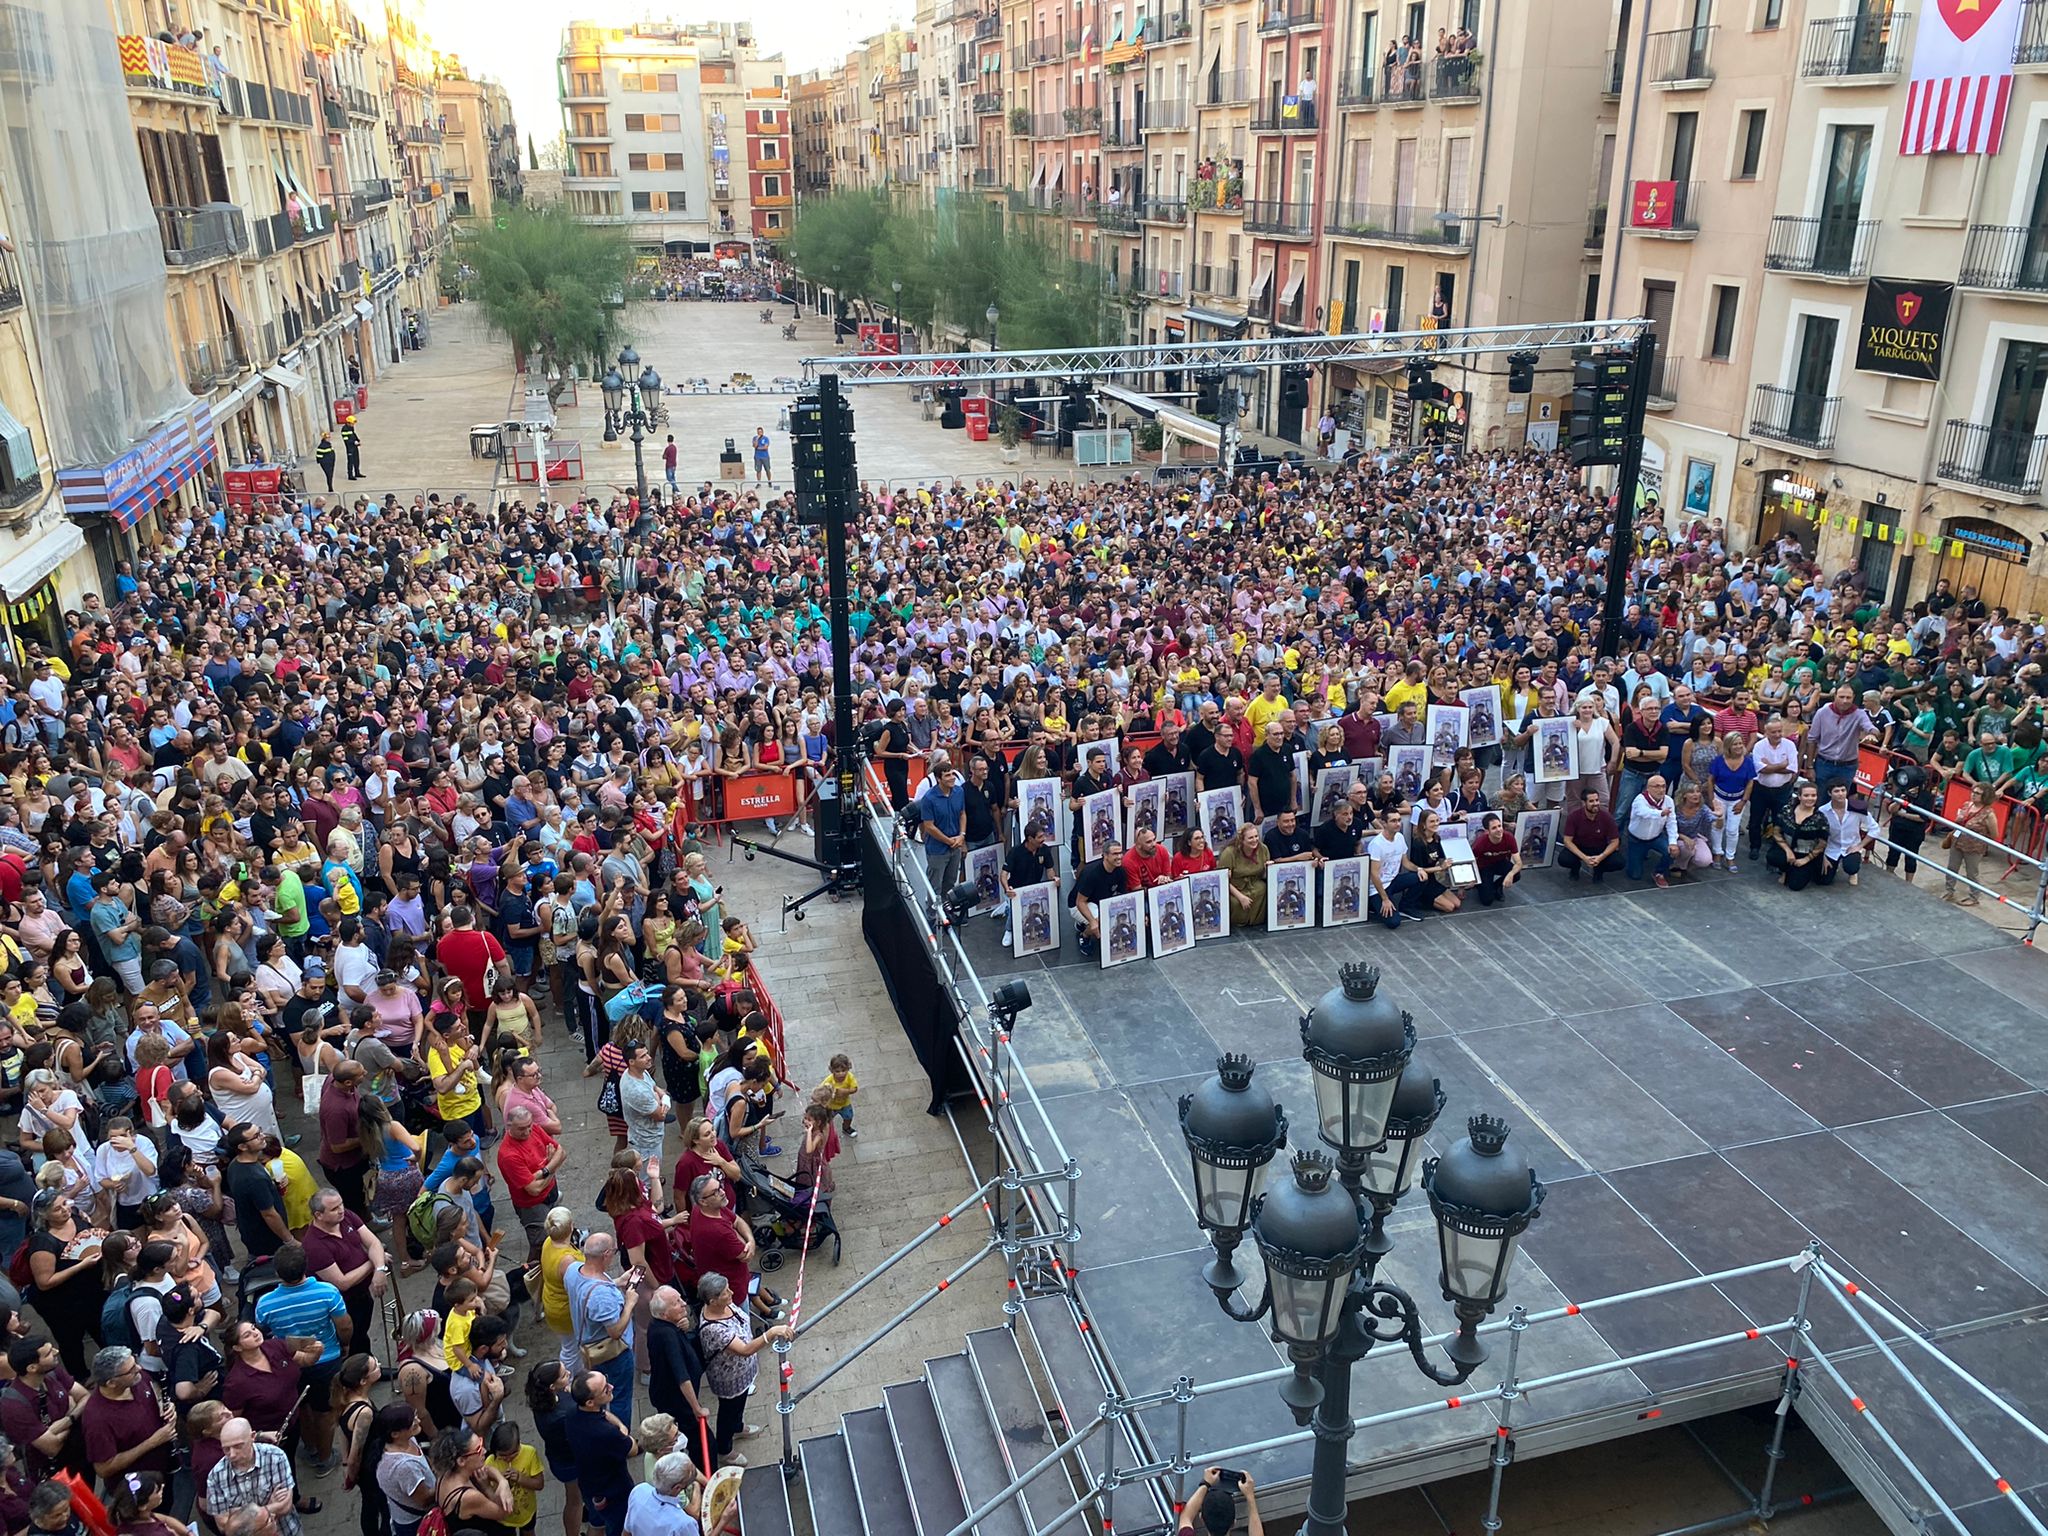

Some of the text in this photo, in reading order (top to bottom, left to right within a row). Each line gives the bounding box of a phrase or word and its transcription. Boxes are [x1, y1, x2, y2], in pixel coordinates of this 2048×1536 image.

[1902, 300, 1914, 317] T
[1868, 326, 1939, 350] XIQUETS
[1873, 345, 1933, 363] TARRAGONA
[1977, 533, 2001, 546] PIZZA
[740, 794, 781, 806] ESTRELLA
